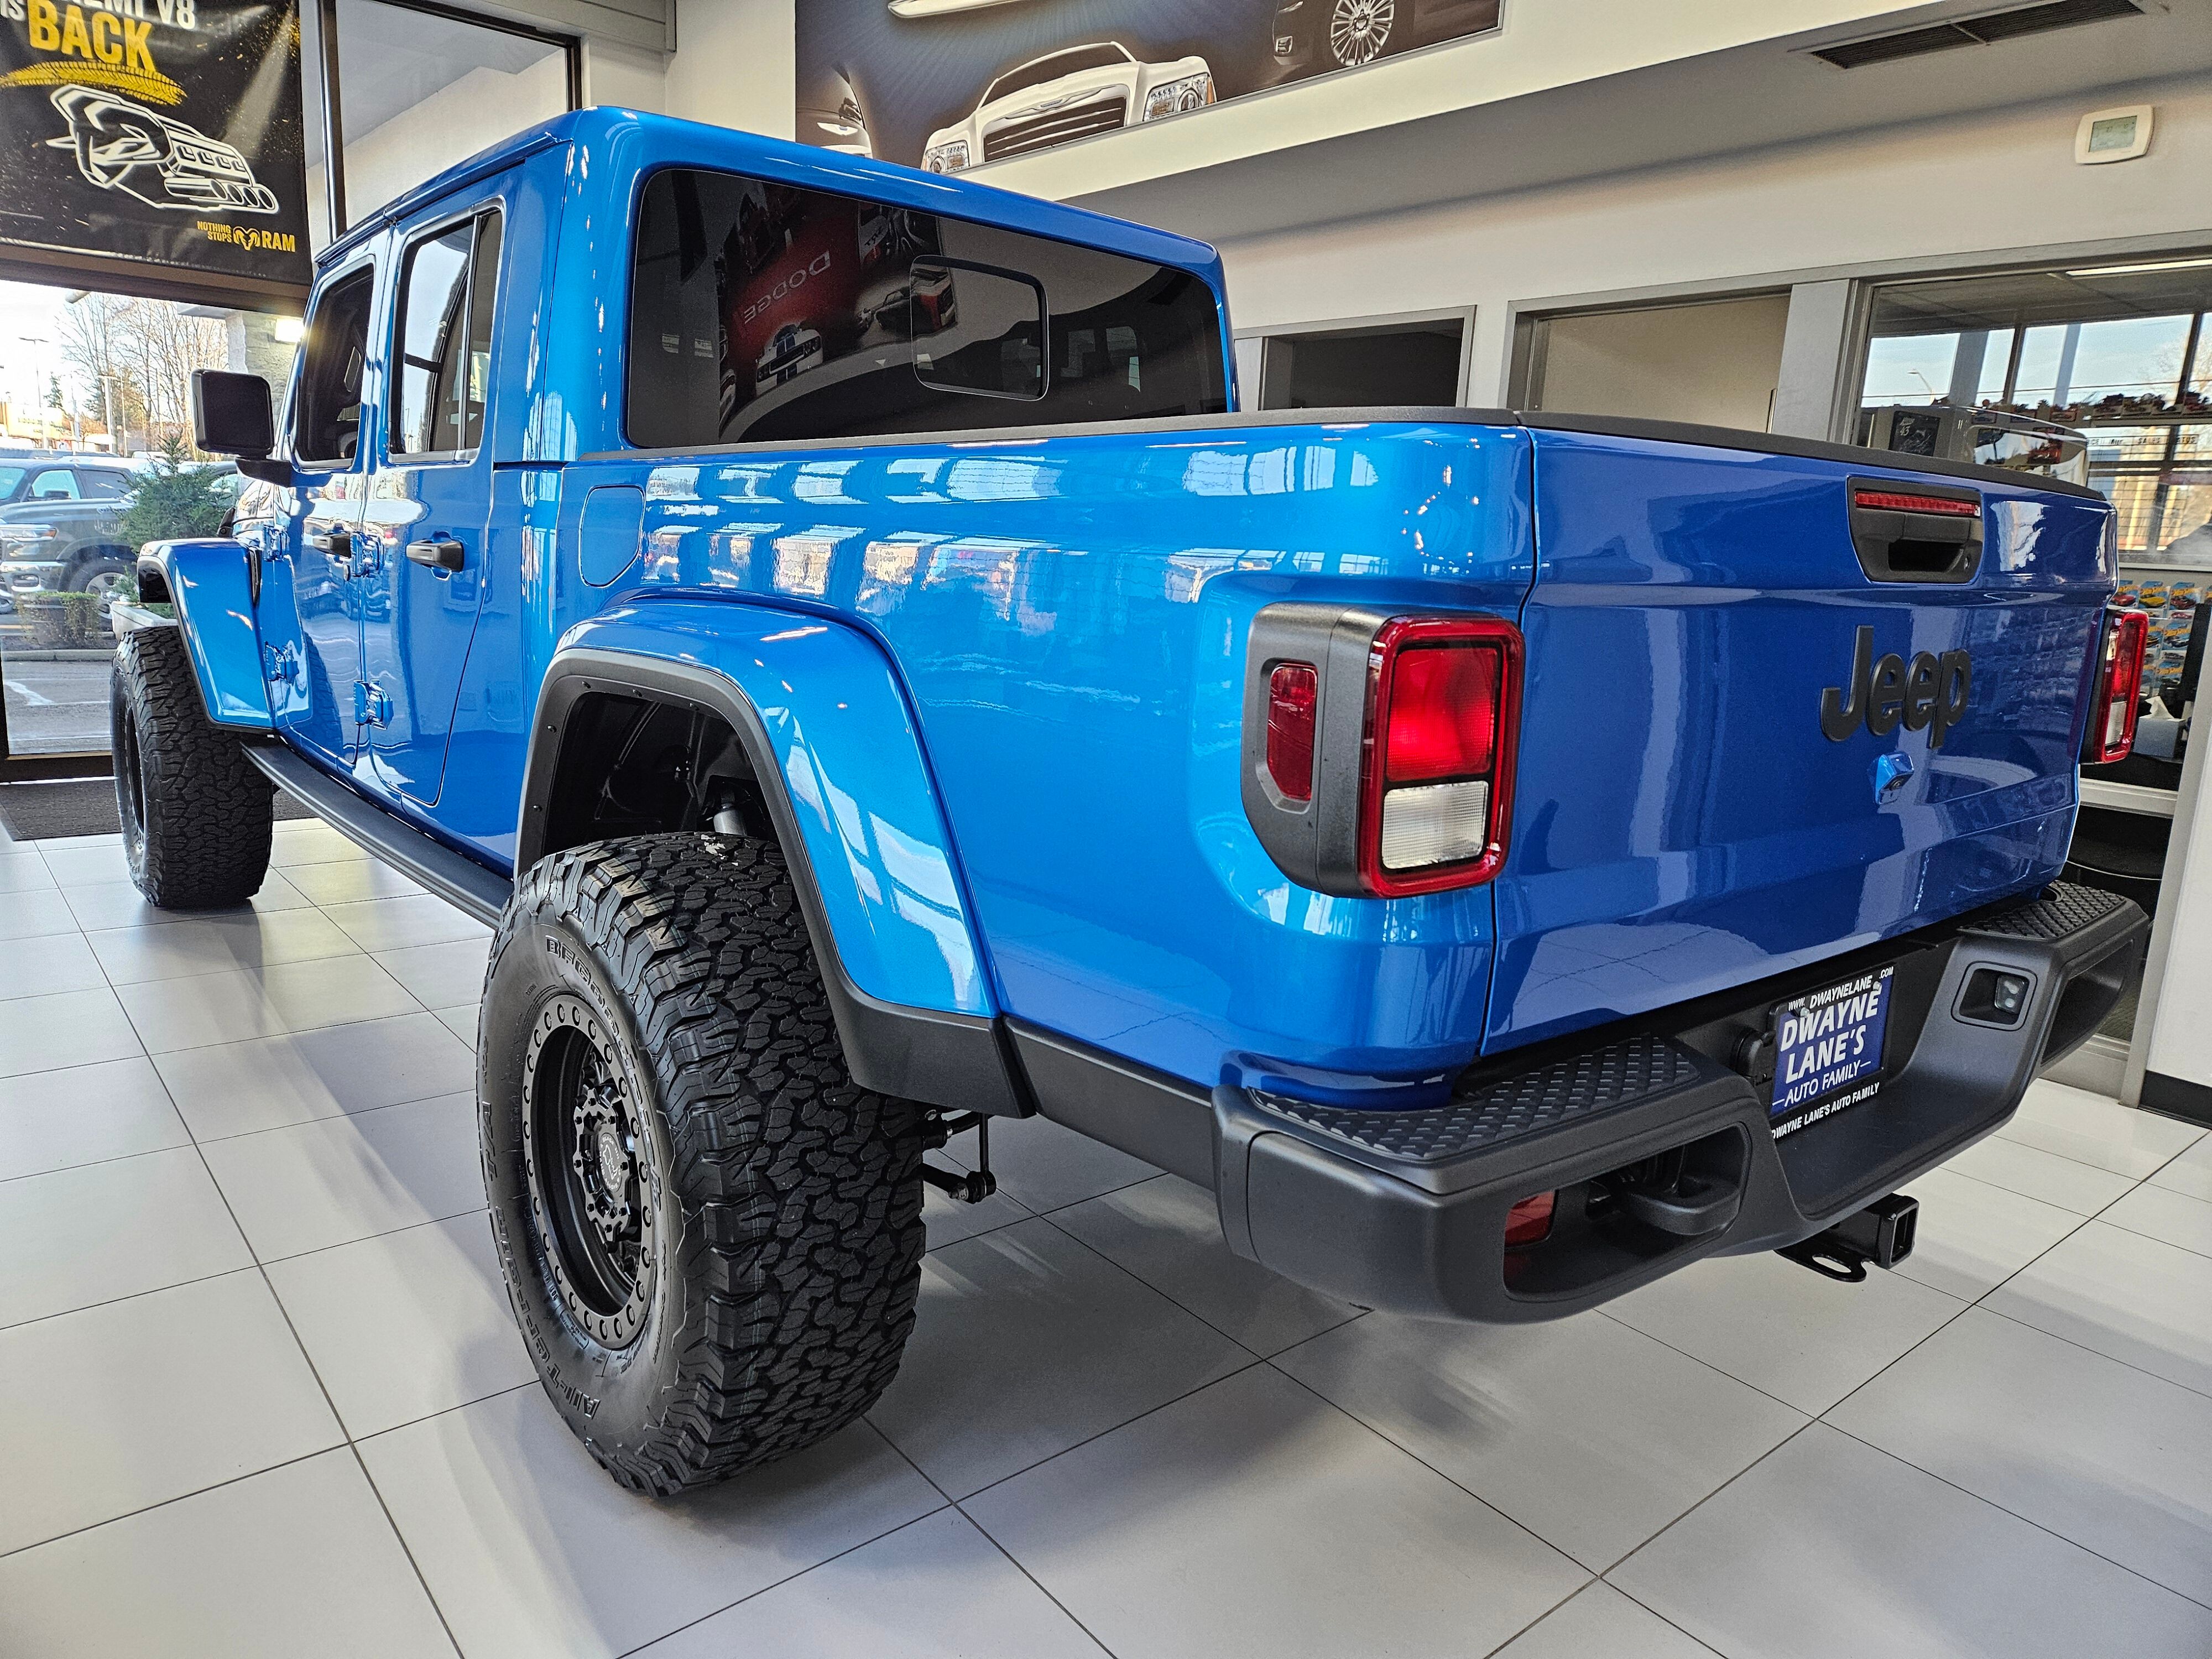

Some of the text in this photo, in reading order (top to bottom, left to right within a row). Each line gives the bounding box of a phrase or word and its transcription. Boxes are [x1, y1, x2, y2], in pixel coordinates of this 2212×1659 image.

[28, 0, 156, 73] BACK
[197, 221, 231, 234] NOTHING
[207, 231, 232, 243] STOPS
[262, 230, 295, 253] RAM
[1821, 625, 1972, 749] Jeep
[1809, 975, 1872, 1009] DWAYNELANE
[1879, 966, 1893, 979] .COM
[1781, 990, 1881, 1052] DWAYNE
[1786, 1025, 1866, 1084] LANE'S
[1785, 1060, 1860, 1107] AUTO FAMILY
[1804, 1105, 1830, 1126] LANE'S
[1832, 1094, 1851, 1115] AUTO
[1853, 1082, 1880, 1103] FAMILY
